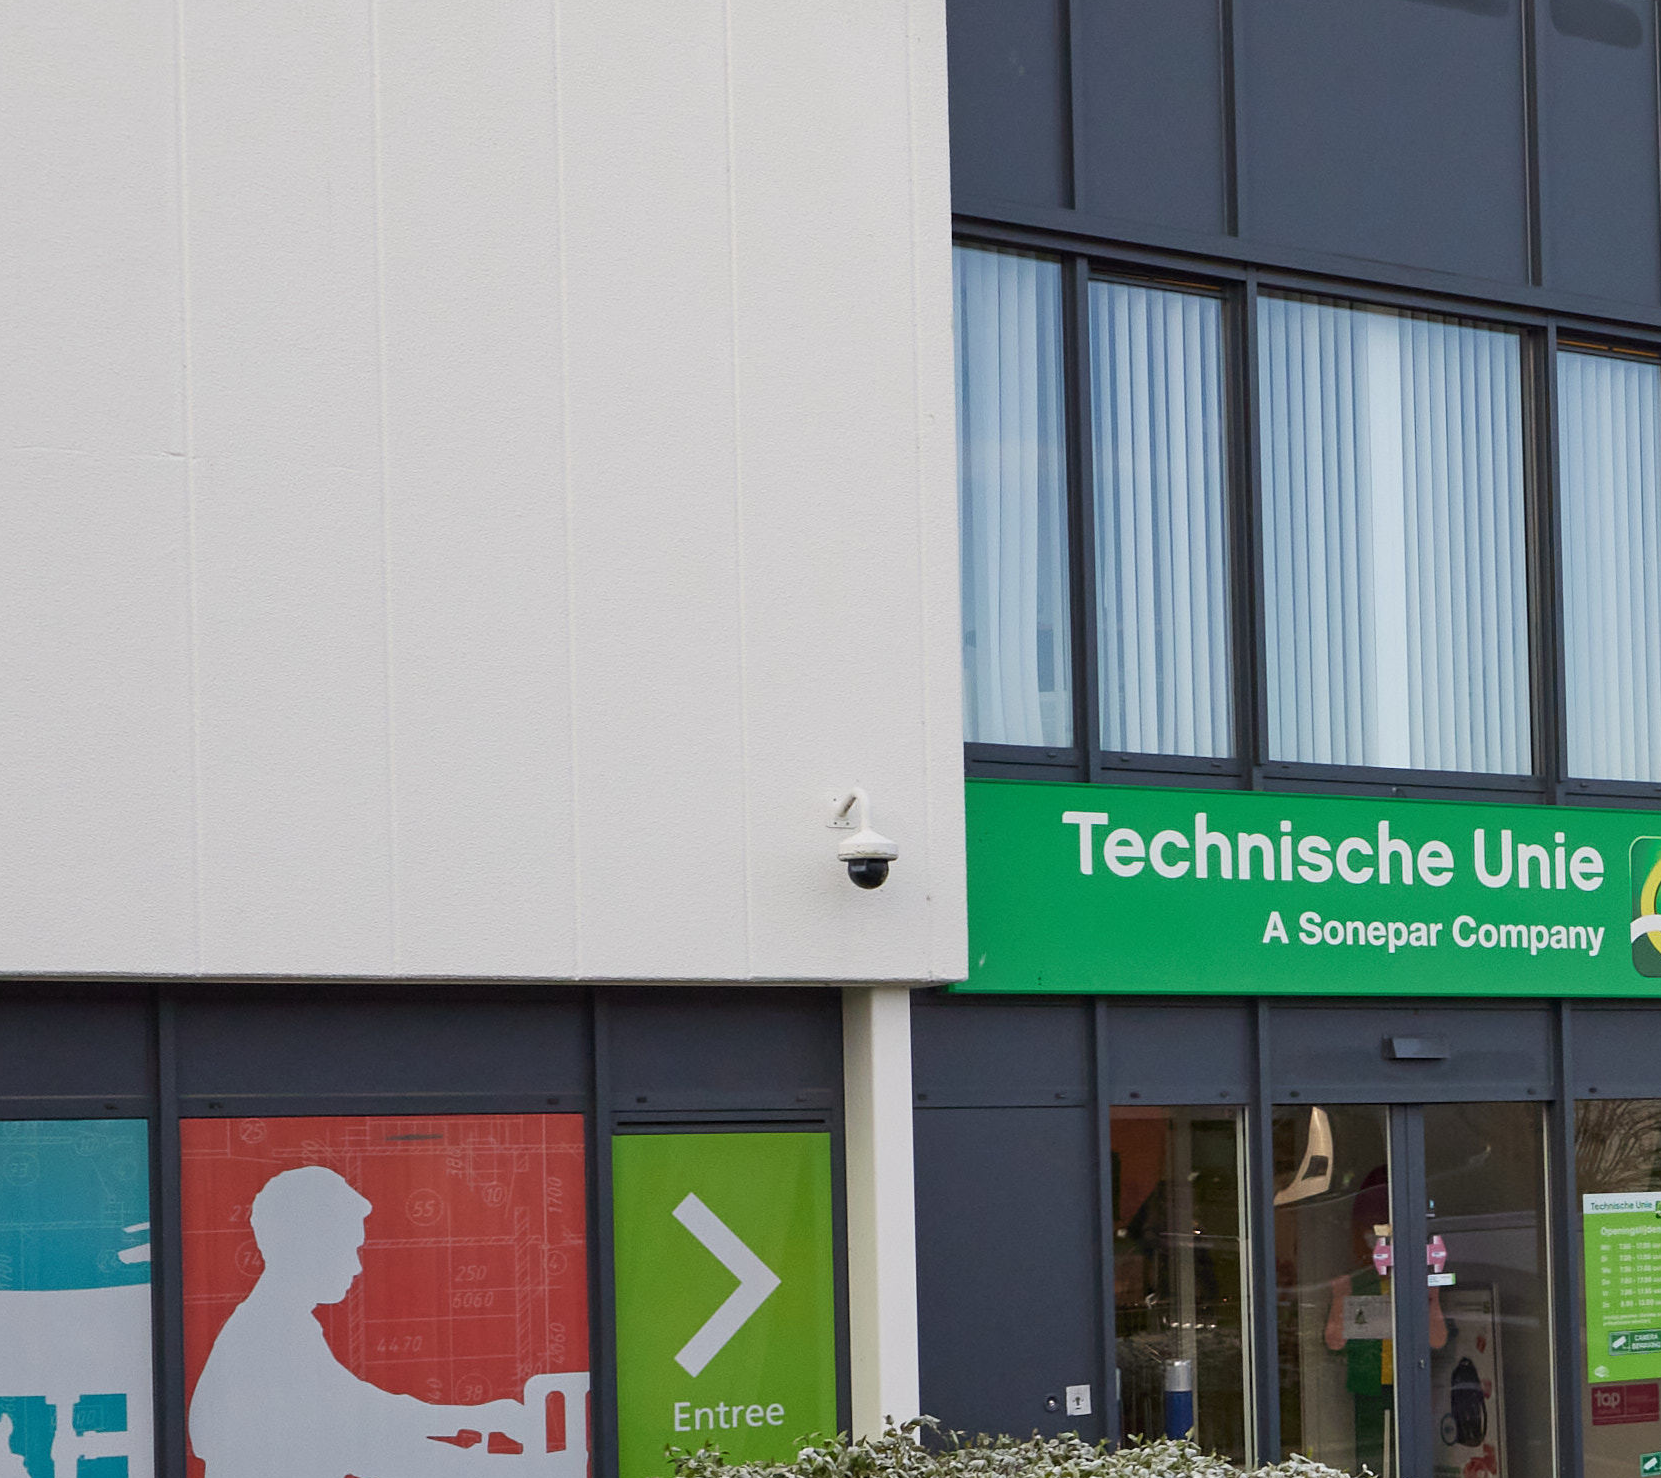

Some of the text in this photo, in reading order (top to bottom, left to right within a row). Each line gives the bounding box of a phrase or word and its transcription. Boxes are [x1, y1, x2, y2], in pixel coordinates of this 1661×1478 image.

[1061, 810, 1605, 891] Technische Unie
[1262, 911, 1605, 957] A Sonepar Company
[242, 1123, 263, 1139] 25
[547, 1176, 564, 1214] 1700
[411, 1199, 436, 1217] 55
[1590, 1200, 1652, 1211] Technische Unie
[455, 1265, 487, 1281] 250
[452, 1292, 494, 1309] 6060
[376, 1335, 423, 1353] 4470
[673, 1401, 785, 1432] Entree
